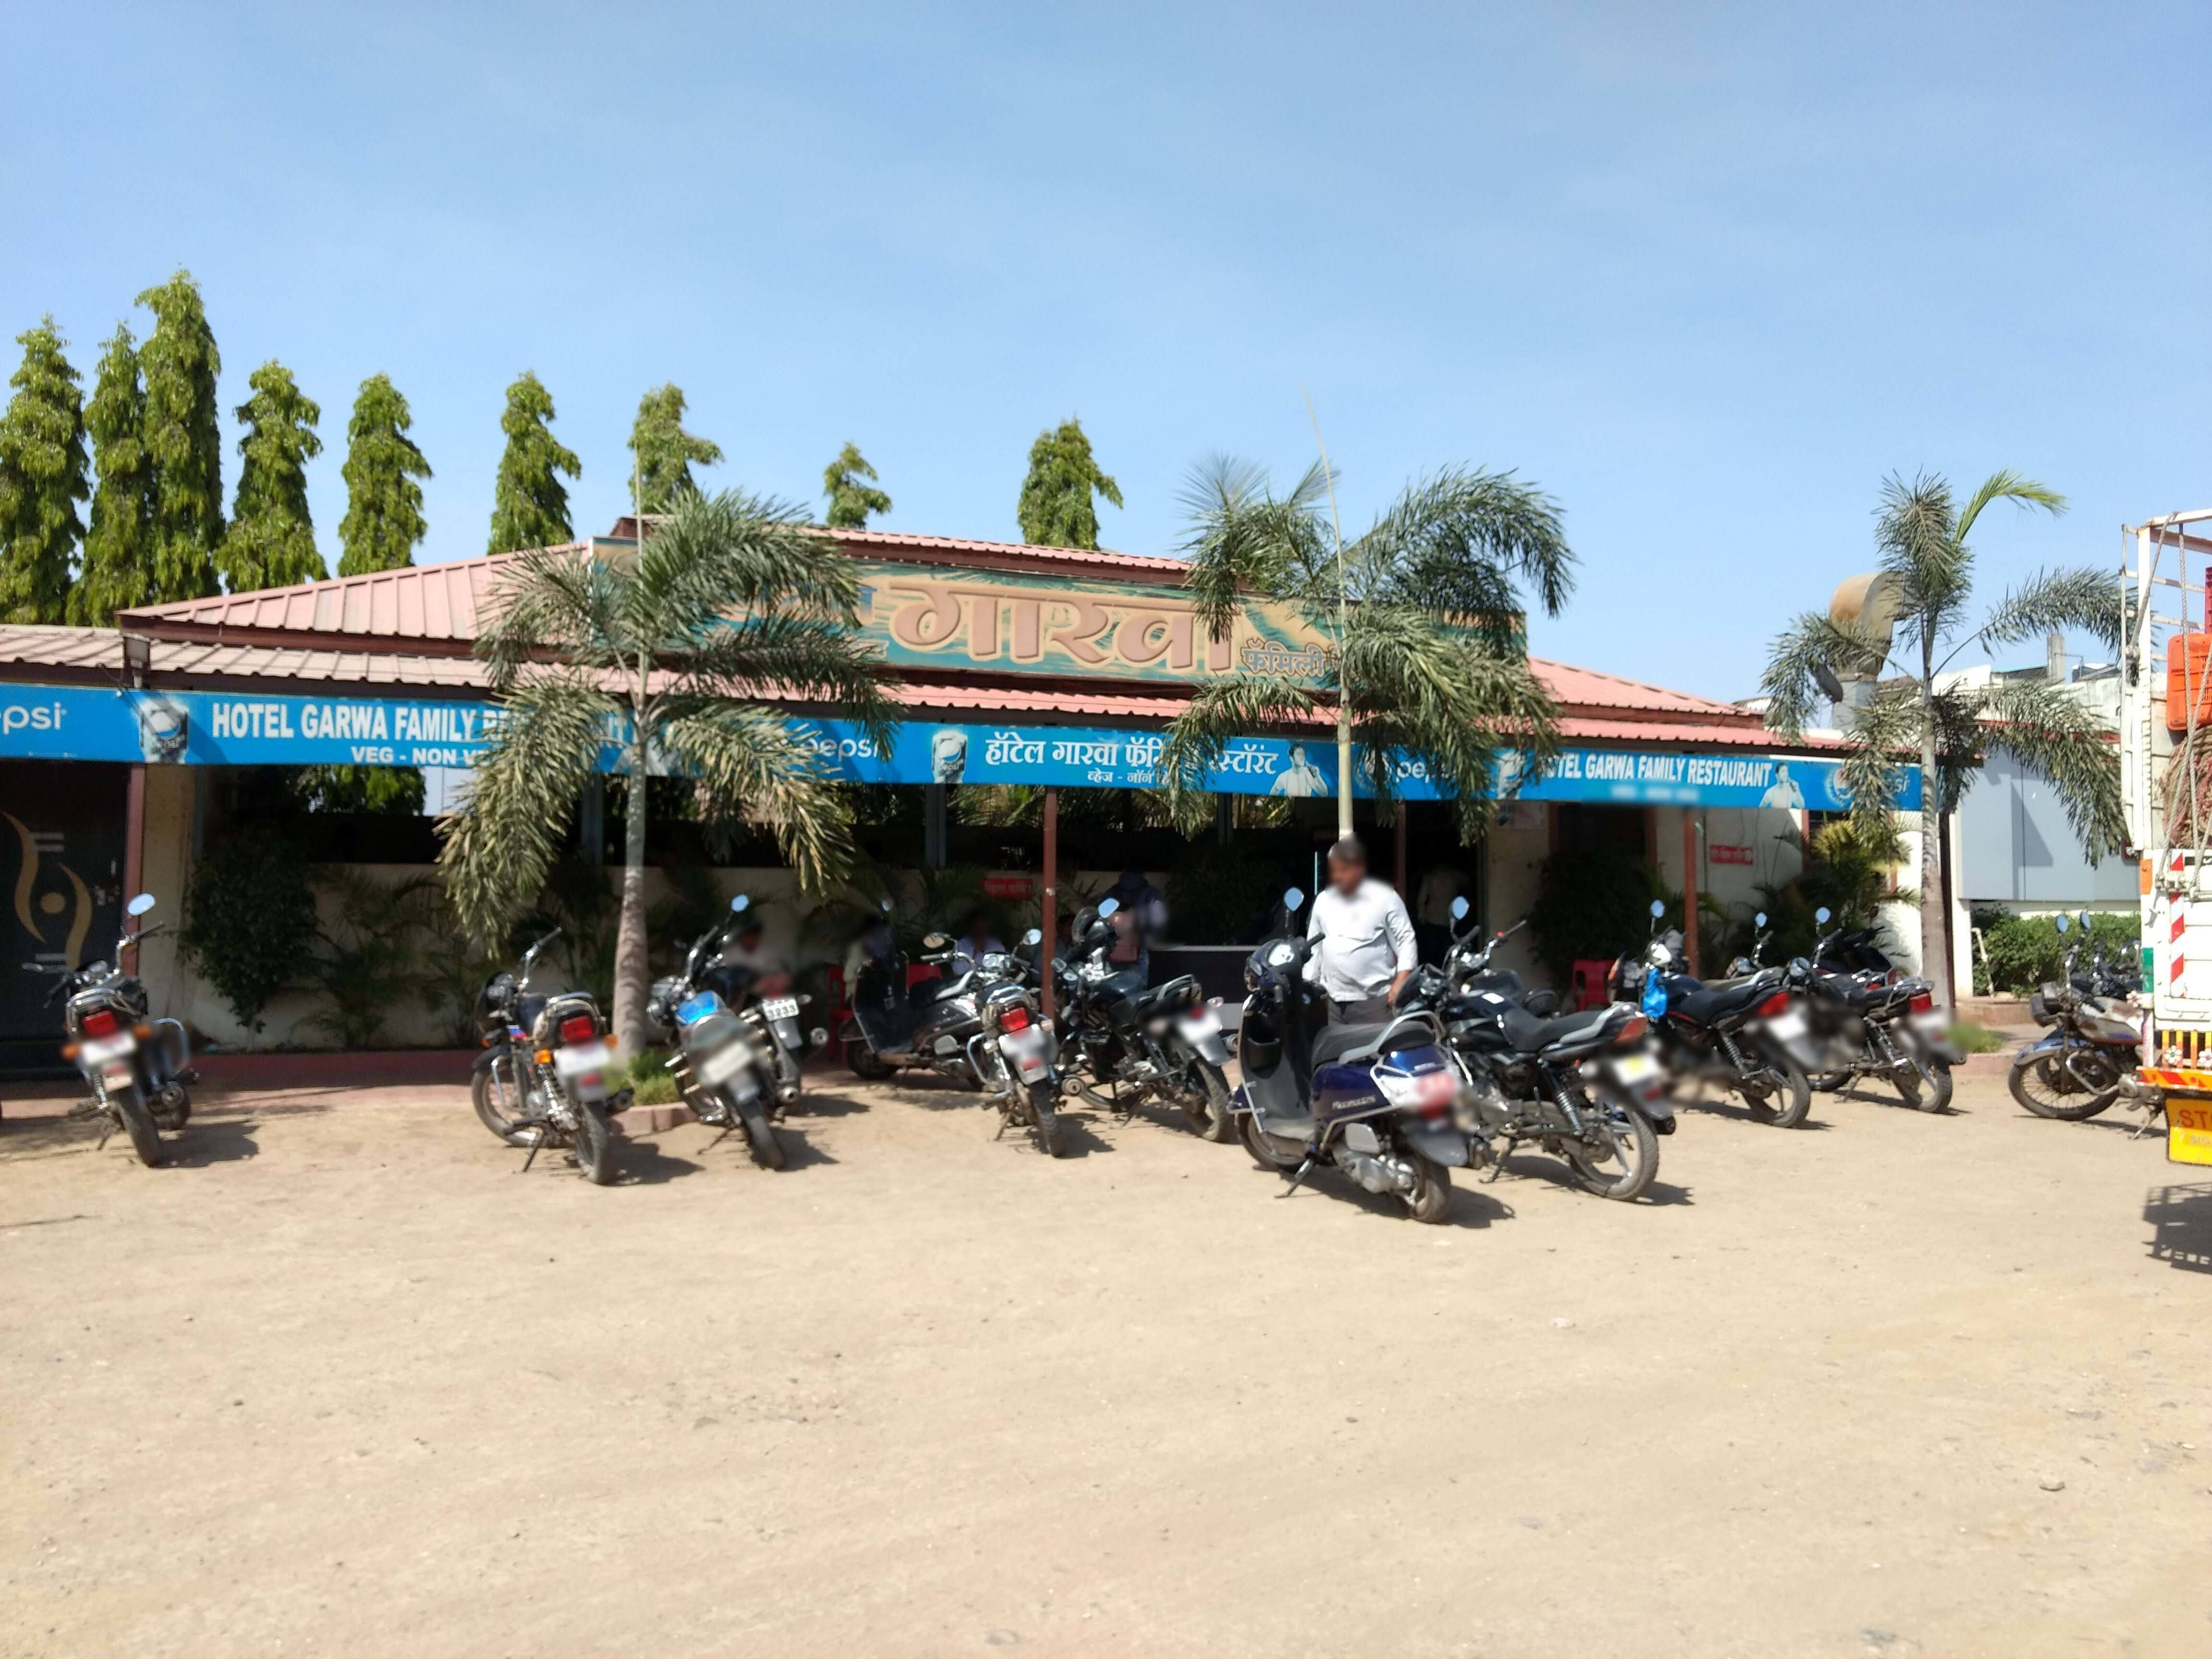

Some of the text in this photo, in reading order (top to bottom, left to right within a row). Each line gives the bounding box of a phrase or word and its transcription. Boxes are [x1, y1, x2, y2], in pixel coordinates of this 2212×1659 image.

[887, 580, 1241, 673] गारवा
[0, 701, 67, 735] psi
[212, 702, 294, 738] HOTEL
[301, 703, 388, 741] GARWA
[394, 707, 477, 743] FAMILY
[351, 746, 393, 763] VEG
[412, 747, 456, 765] NON
[985, 731, 1046, 765] हॉटेल
[1052, 741, 1118, 766] गारवा
[1586, 754, 1635, 780] GARWA
[1637, 755, 1686, 781] FAMILY
[1687, 758, 1773, 787] RESTAURANT
[2179, 1109, 2212, 1130] ST
